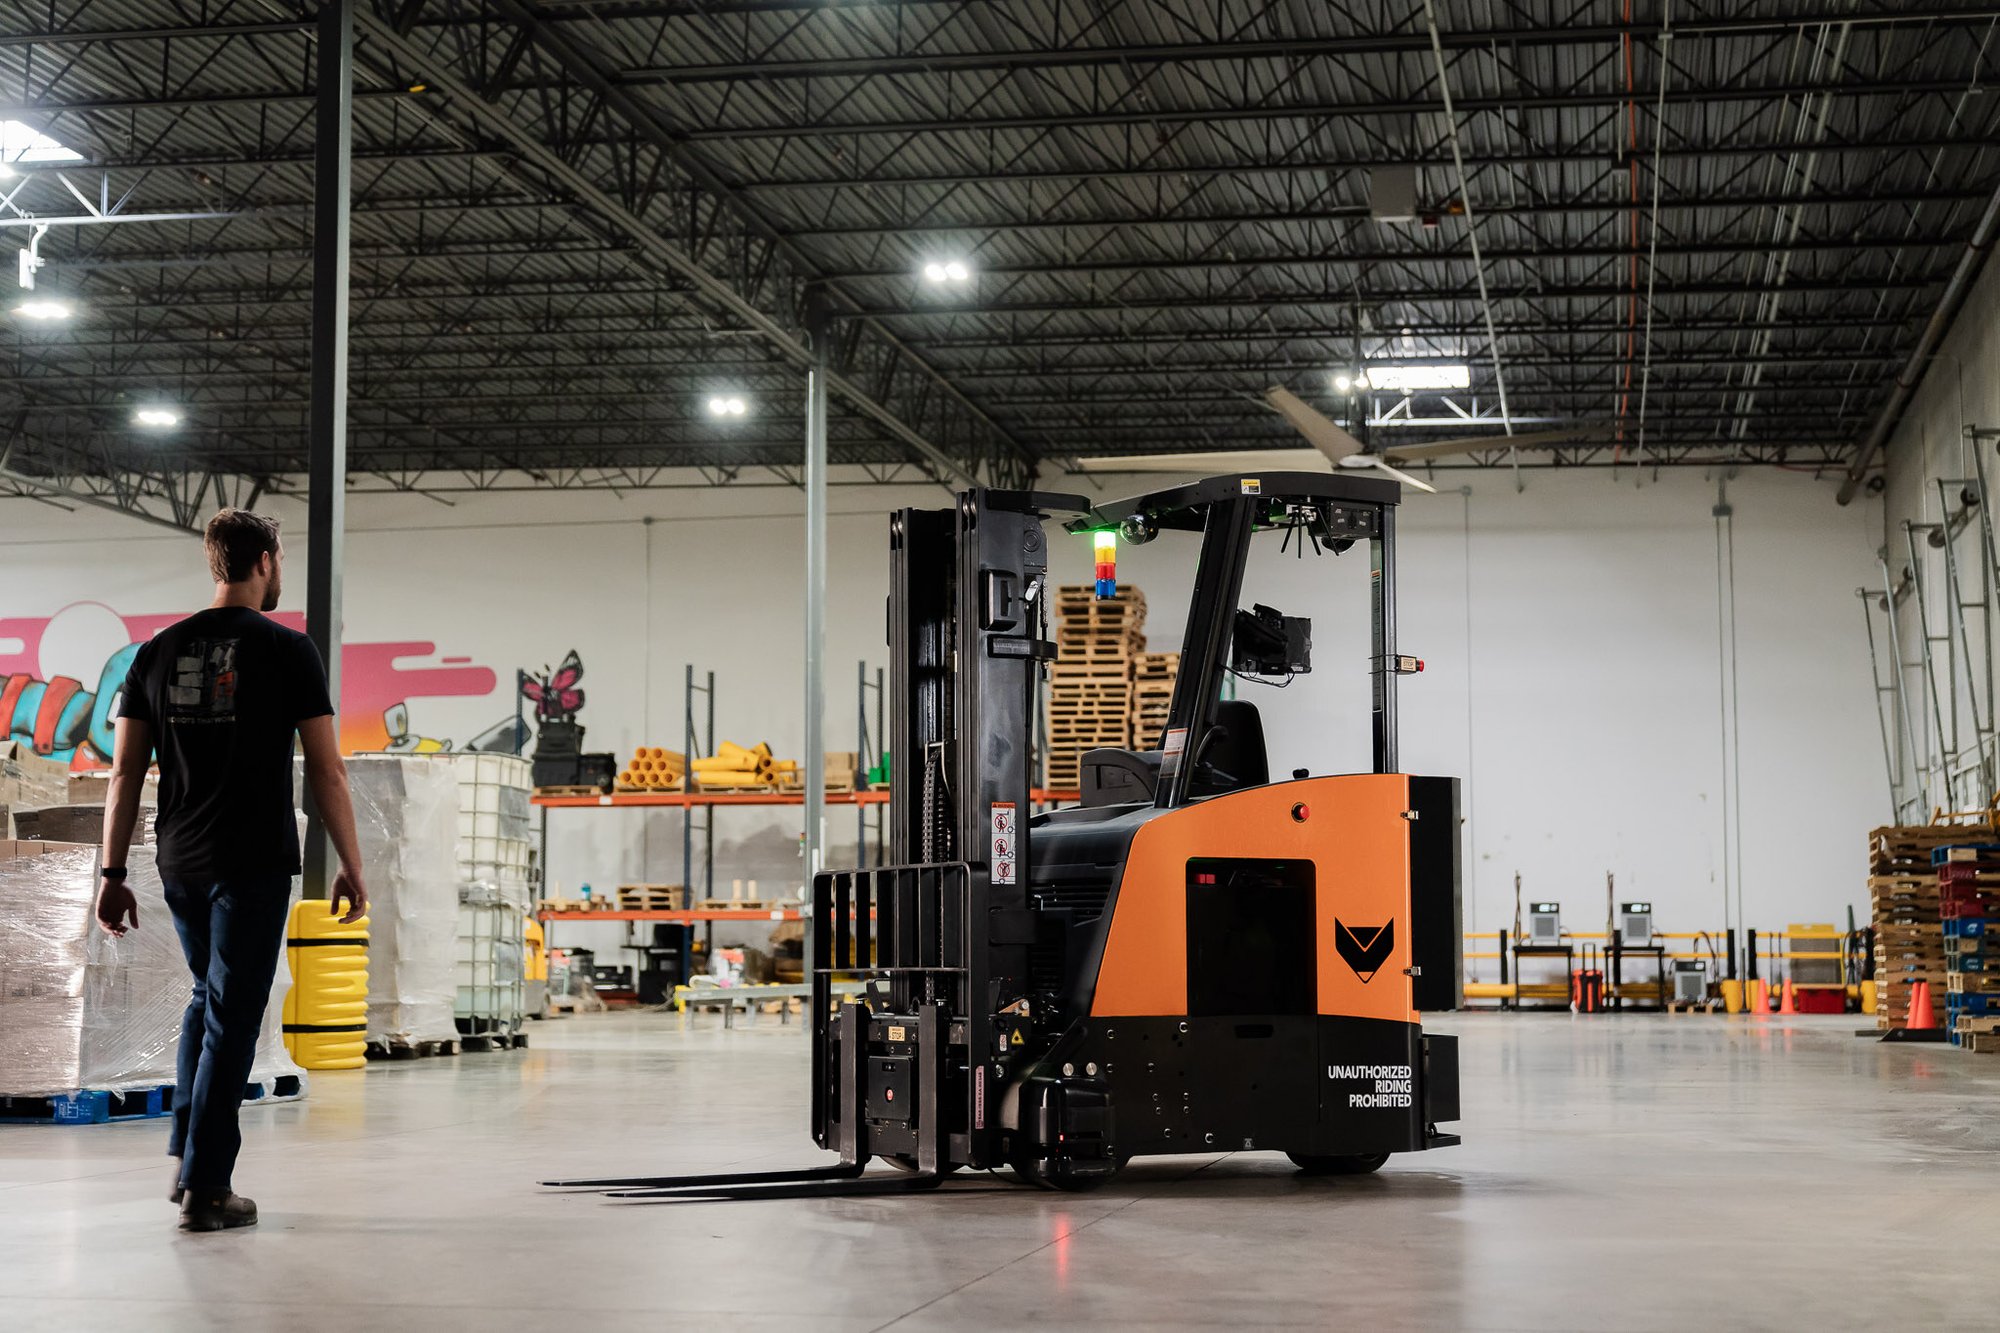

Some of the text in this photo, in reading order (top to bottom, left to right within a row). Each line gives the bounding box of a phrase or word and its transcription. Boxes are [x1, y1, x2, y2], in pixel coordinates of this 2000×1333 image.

[1328, 1065, 1412, 1079] UNAUTHORIZED
[1375, 1080, 1412, 1093] RIDING
[1349, 1094, 1412, 1108] PROHIBITED
